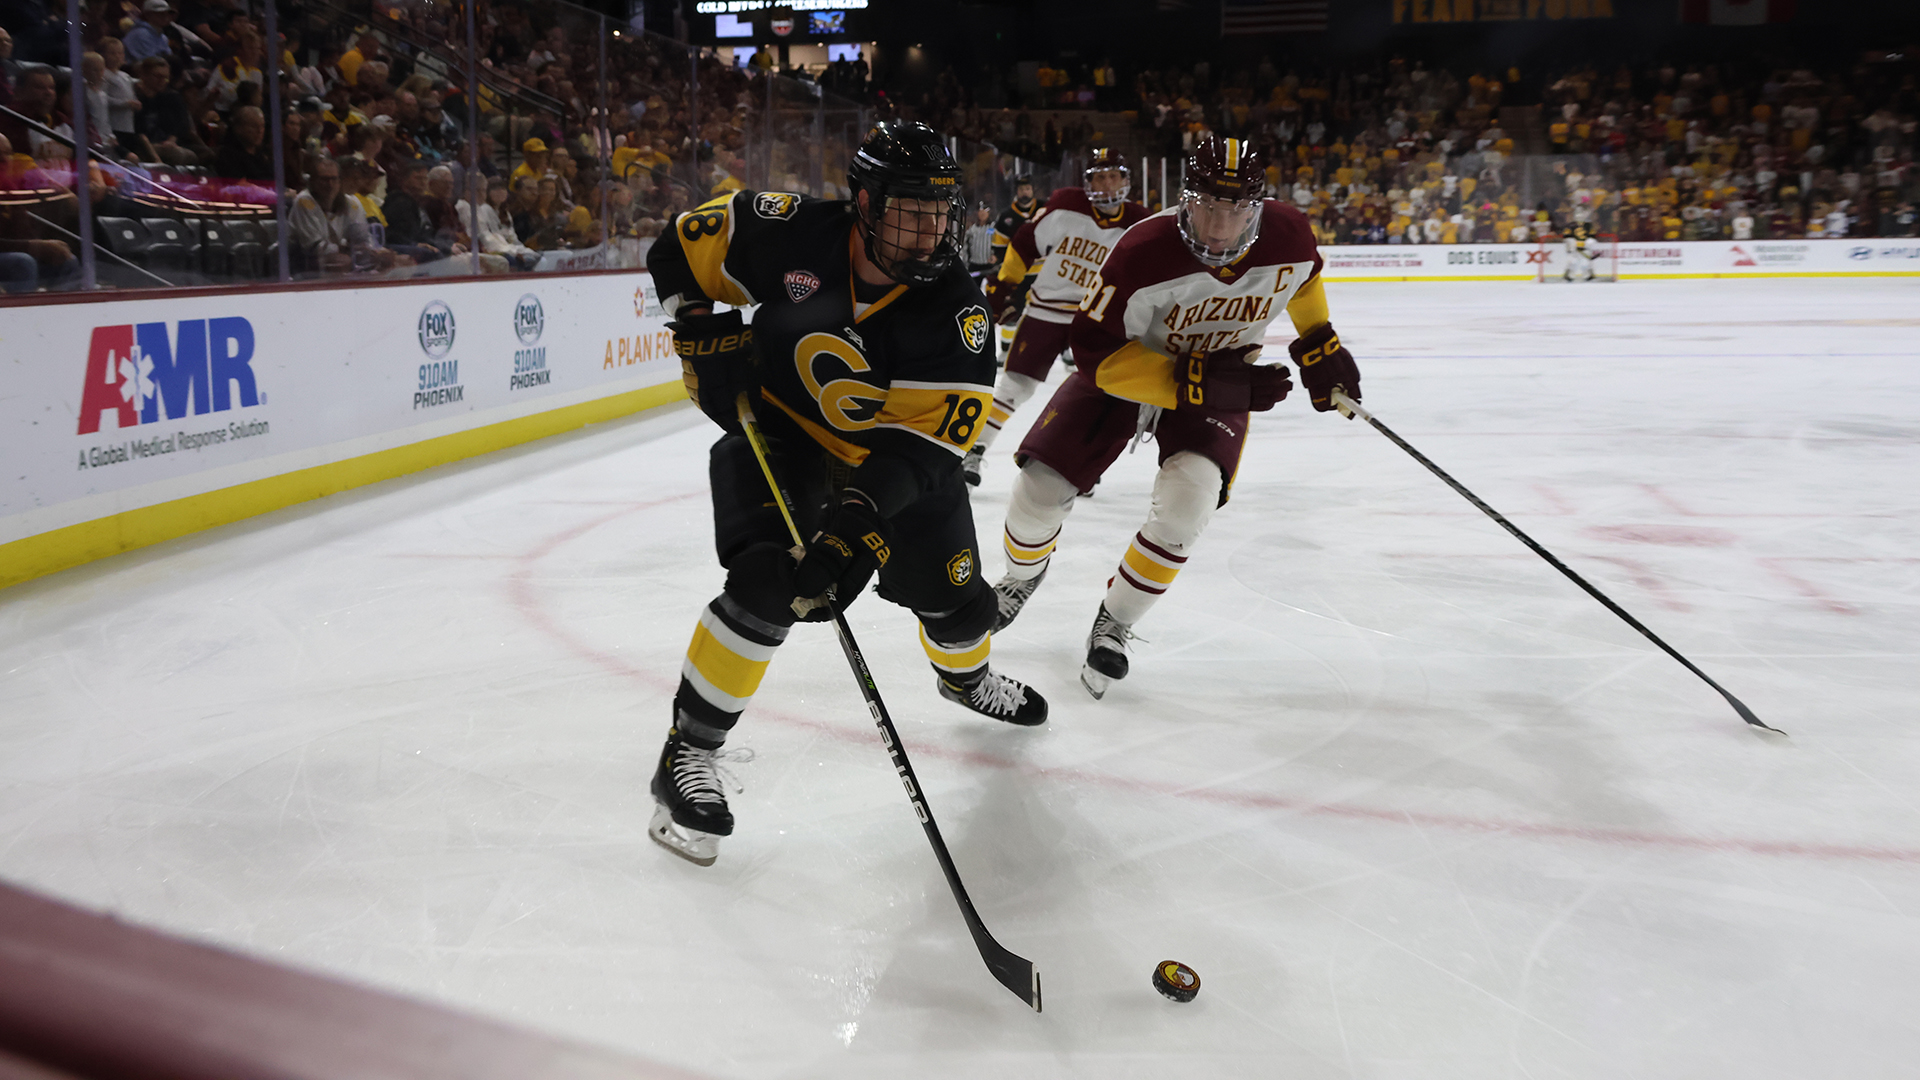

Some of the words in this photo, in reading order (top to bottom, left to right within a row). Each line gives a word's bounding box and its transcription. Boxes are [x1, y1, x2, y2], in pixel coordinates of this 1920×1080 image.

[929, 177, 955, 186] TIGERS
[1056, 236, 1108, 266] ARIZO
[1448, 251, 1474, 264] DOS
[1478, 251, 1518, 264] EQUIS
[786, 274, 819, 289] NCHC
[1057, 259, 1098, 288] STAT
[1273, 265, 1294, 294] C
[426, 312, 448, 337] FOX
[520, 304, 538, 326] FOX
[1163, 295, 1273, 332] ARIZONA
[426, 337, 449, 348] SPORTS
[603, 340, 614, 370] A
[618, 334, 652, 367] PLAN
[655, 331, 677, 360] FO
[1165, 326, 1249, 355] STATE
[1302, 335, 1340, 367] CC
[514, 347, 546, 373] 910AM
[77, 316, 259, 435] AMR
[418, 360, 458, 390] 910AM
[510, 370, 551, 391] PHOENIX
[1187, 351, 1204, 405] CC
[413, 385, 464, 410] PHOENIX
[933, 394, 983, 445] 18
[1206, 417, 1236, 437] CCM
[77, 449, 88, 471] A
[89, 442, 129, 467] Global
[131, 433, 176, 459] Medical
[178, 424, 227, 452] Response
[229, 418, 270, 441] Solution
